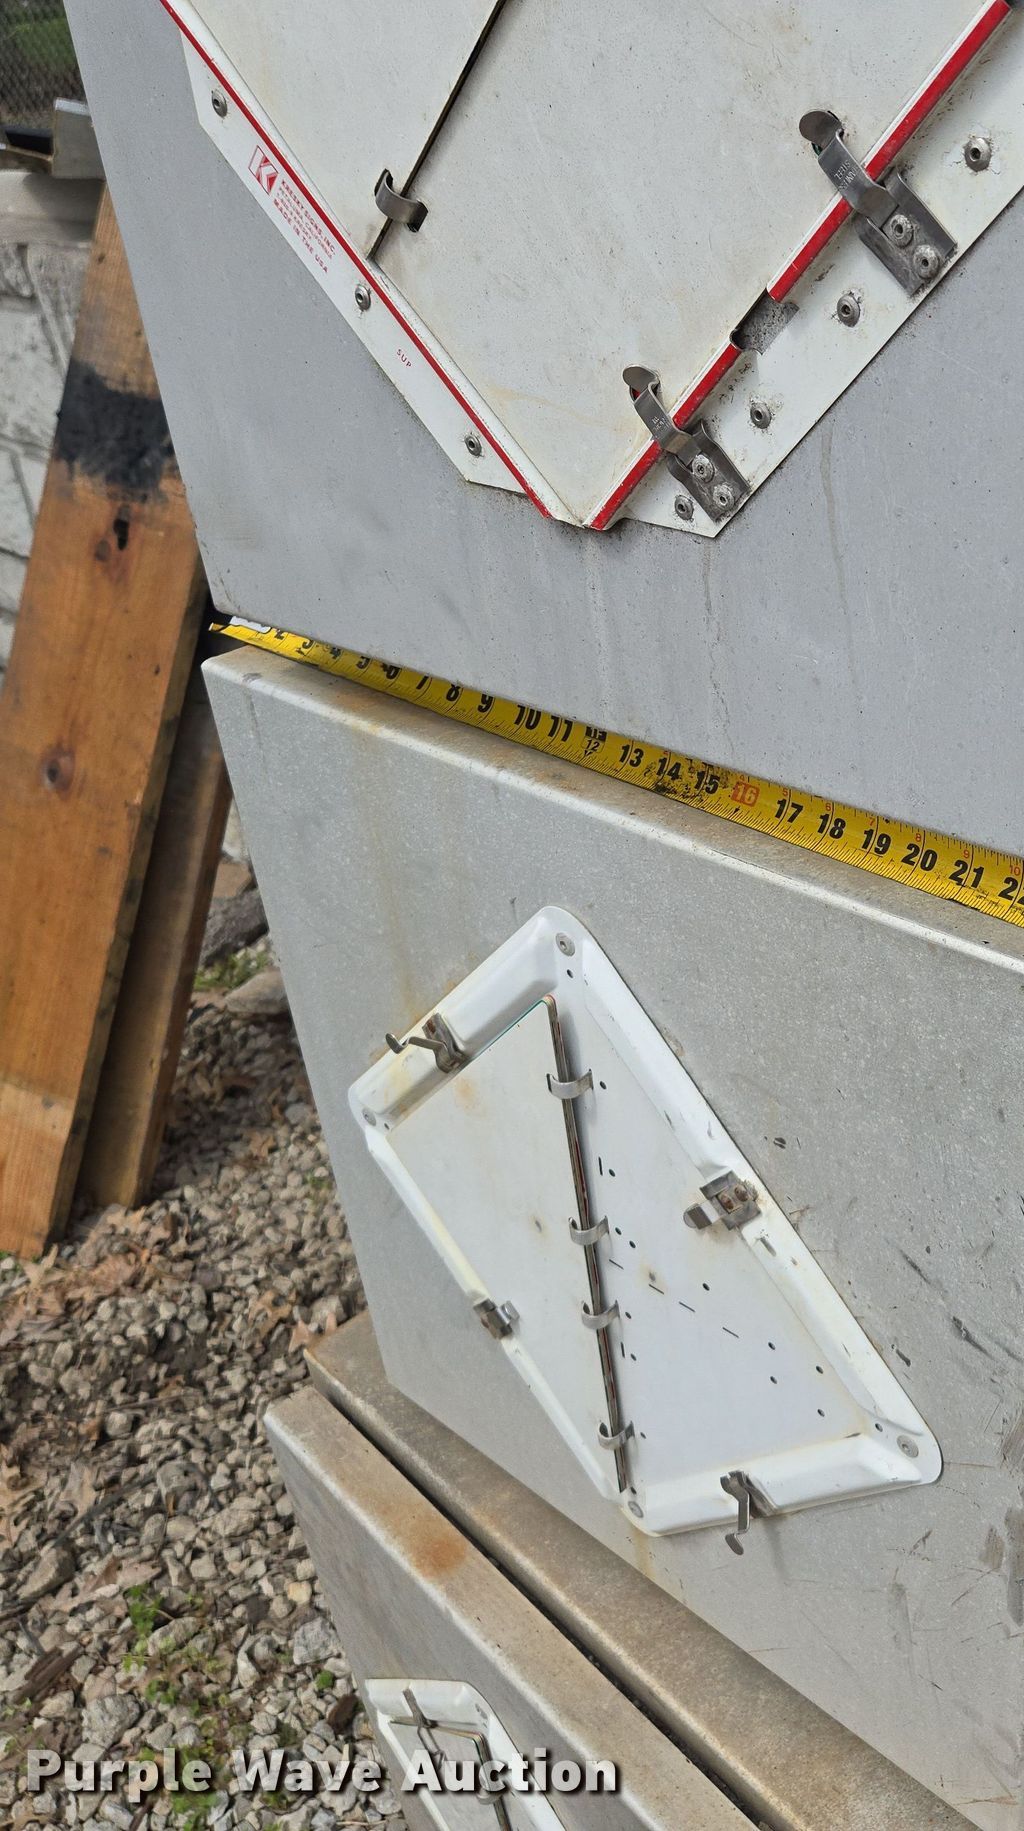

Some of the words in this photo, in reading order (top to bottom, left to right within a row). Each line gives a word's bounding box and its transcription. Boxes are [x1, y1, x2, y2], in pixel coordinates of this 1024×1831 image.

[314, 253, 328, 273] USA
[396, 348, 412, 367] SUP
[477, 694, 495, 713] 9
[514, 705, 541, 730] 10
[548, 715, 573, 742] 11
[586, 740, 600, 752] 12
[620, 744, 645, 768] 13
[656, 757, 683, 781] 14
[694, 769, 721, 795] 15
[737, 783, 756, 804] 16
[776, 799, 803, 825] 17
[817, 813, 847, 840] 18
[862, 829, 892, 855] 19
[901, 842, 938, 872] 20
[949, 860, 985, 889] 21
[825, 801, 831, 812] 6
[869, 817, 875, 827] 7
[914, 833, 922, 843] 8
[963, 849, 970, 859] 9
[1009, 864, 1021, 876] 10
